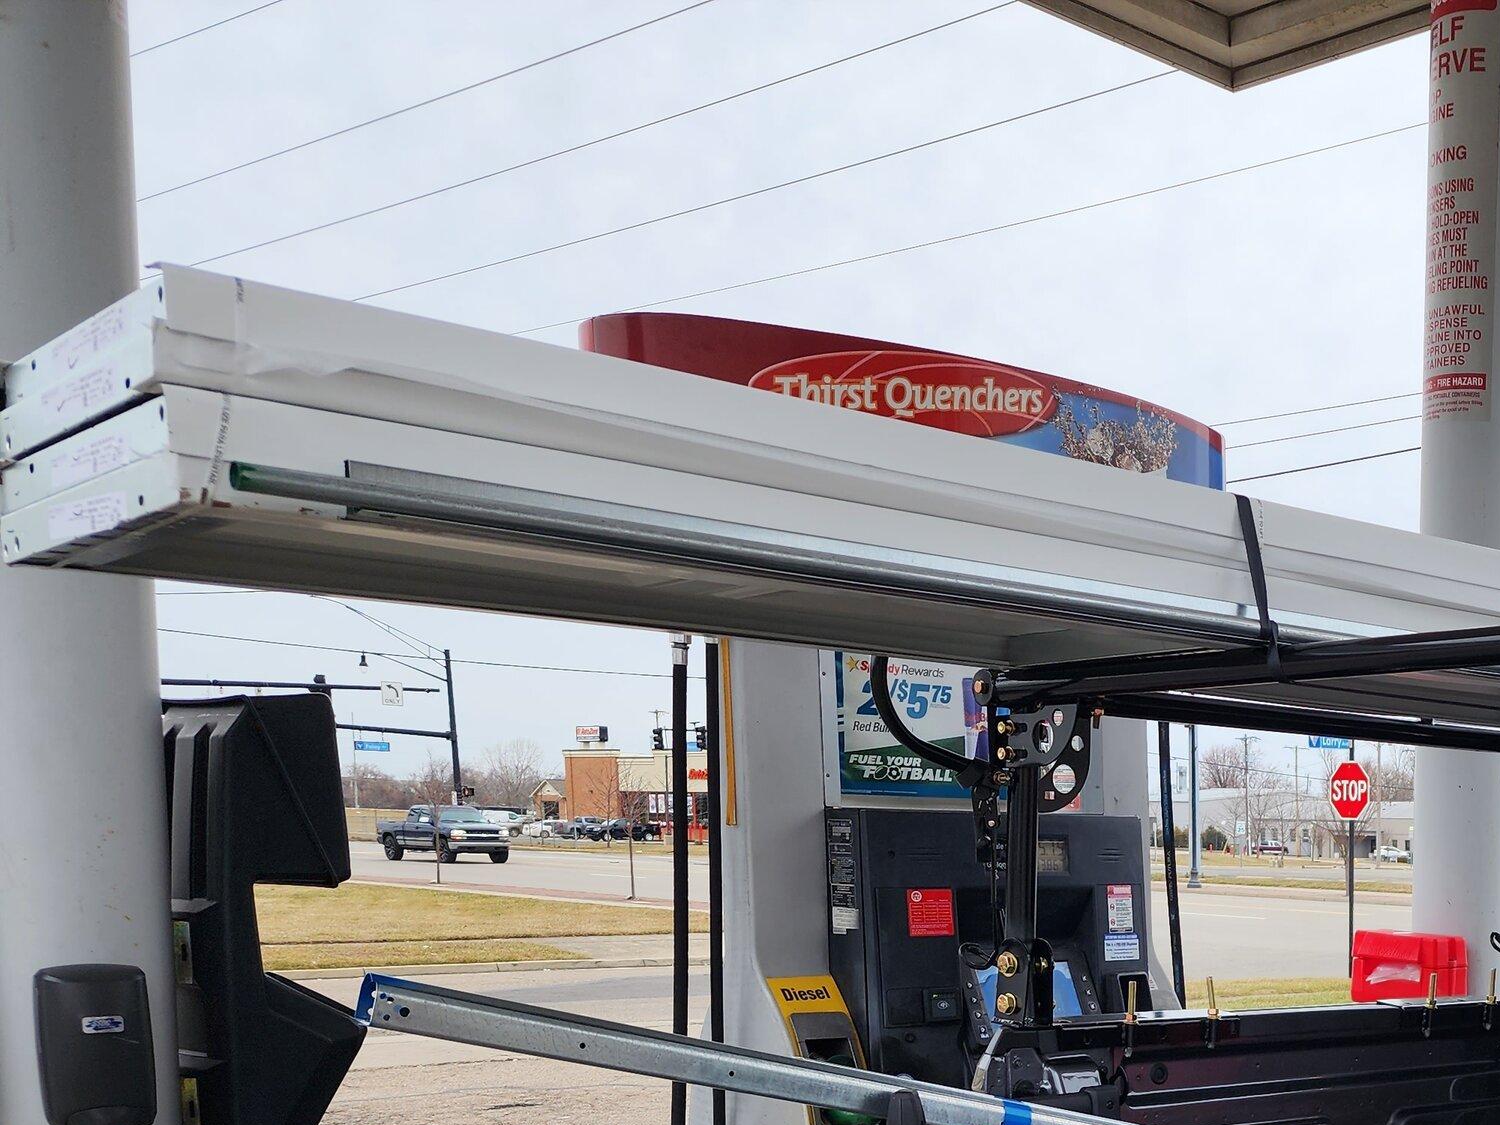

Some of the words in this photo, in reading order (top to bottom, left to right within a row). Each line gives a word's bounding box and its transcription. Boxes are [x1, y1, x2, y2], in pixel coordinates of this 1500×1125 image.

[1445, 177, 1474, 194] USING
[1442, 227, 1468, 242] MUST
[1450, 243, 1467, 258] THE
[1450, 259, 1479, 274] POINT
[1437, 275, 1488, 292] REFUELING
[1453, 329, 1482, 341] INTO
[1437, 378, 1451, 388] FIRE
[1452, 377, 1484, 387] HAZARD
[774, 374, 877, 410] Thirst
[884, 377, 1042, 417] Quenchers
[901, 664, 944, 678] Rewards
[852, 721, 871, 732] Red
[849, 754, 883, 765] FUEL
[887, 755, 922, 767] YOUR
[1332, 780, 1367, 801] STOP
[780, 986, 831, 1001] Diesel
